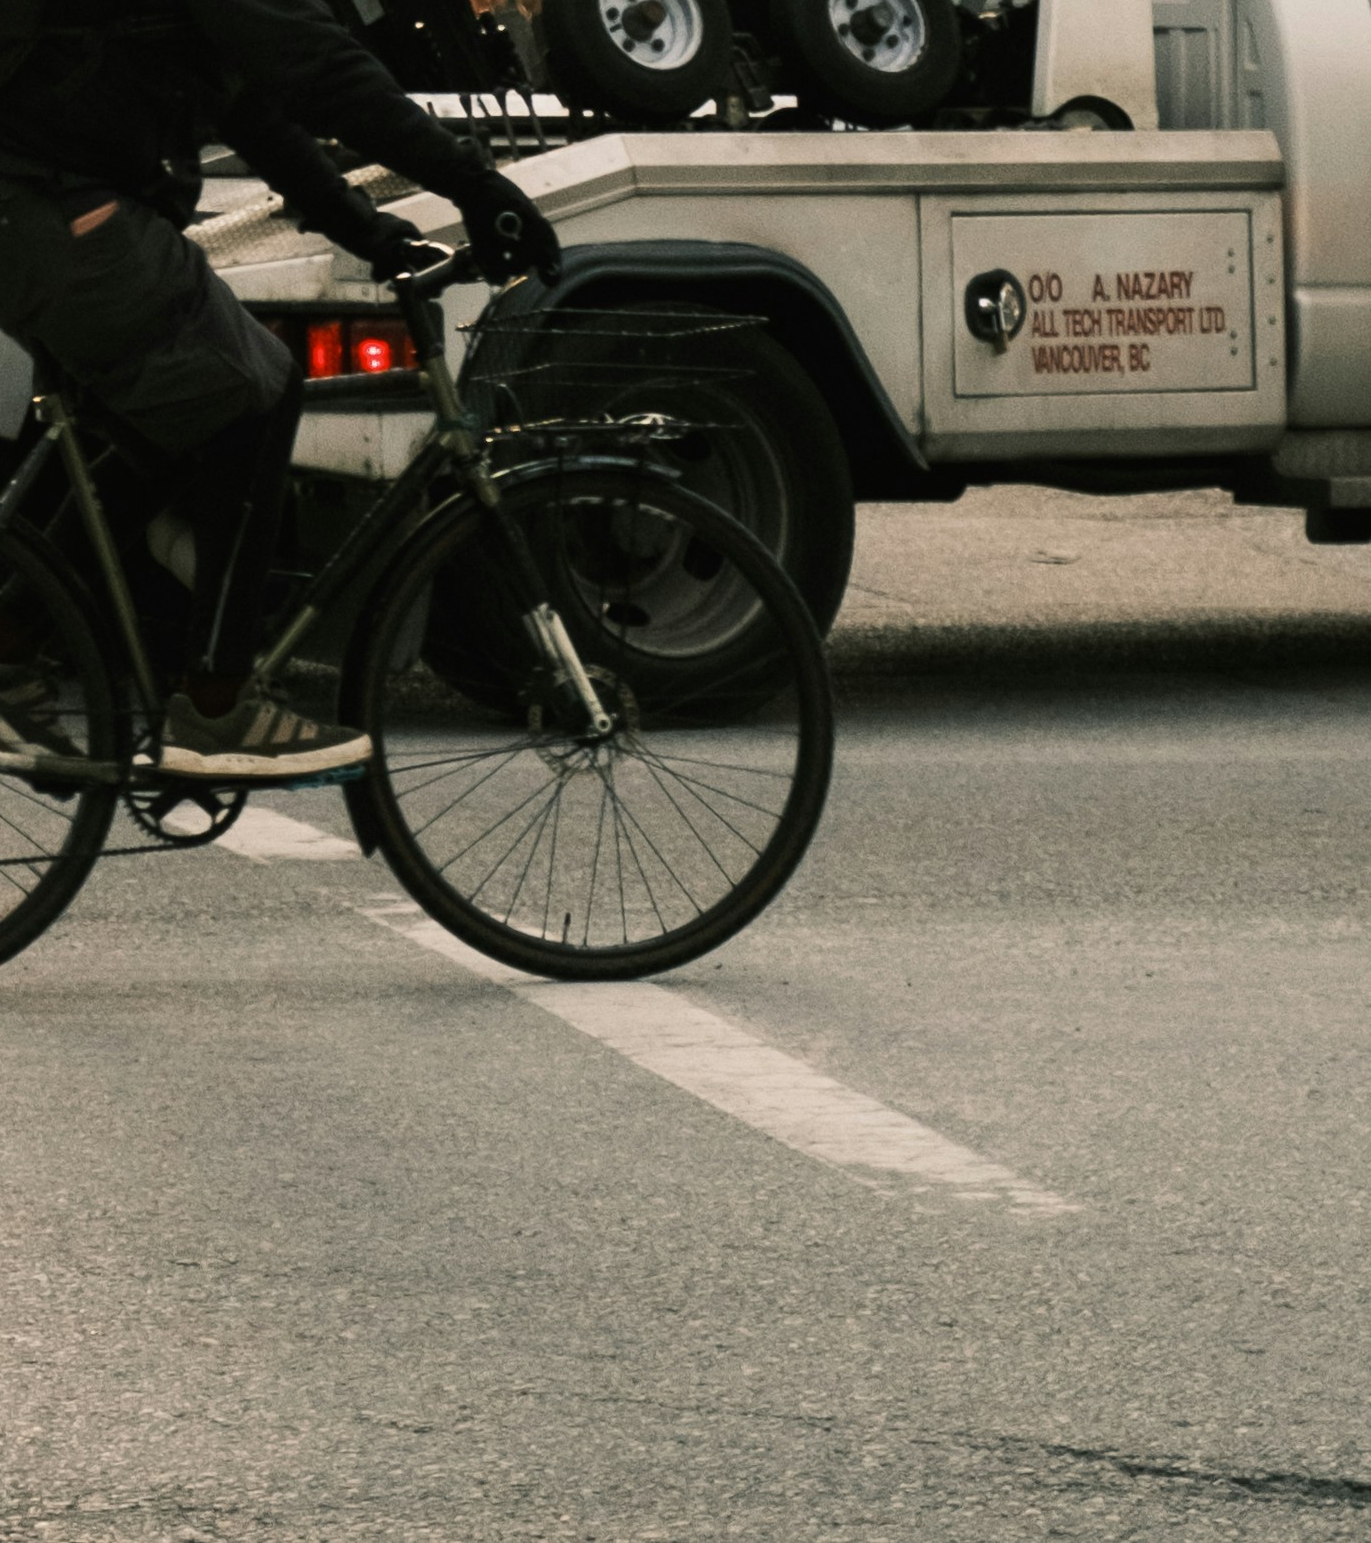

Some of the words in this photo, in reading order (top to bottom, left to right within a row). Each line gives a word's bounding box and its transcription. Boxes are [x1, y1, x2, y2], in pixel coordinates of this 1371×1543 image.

[1117, 271, 1194, 301] NAZARY
[1031, 309, 1059, 338] ALL
[1062, 308, 1102, 338] TECH
[1105, 307, 1195, 337] TRANSPORT
[1031, 343, 1125, 378] VANCOUVER,
[1128, 343, 1151, 372] BC
